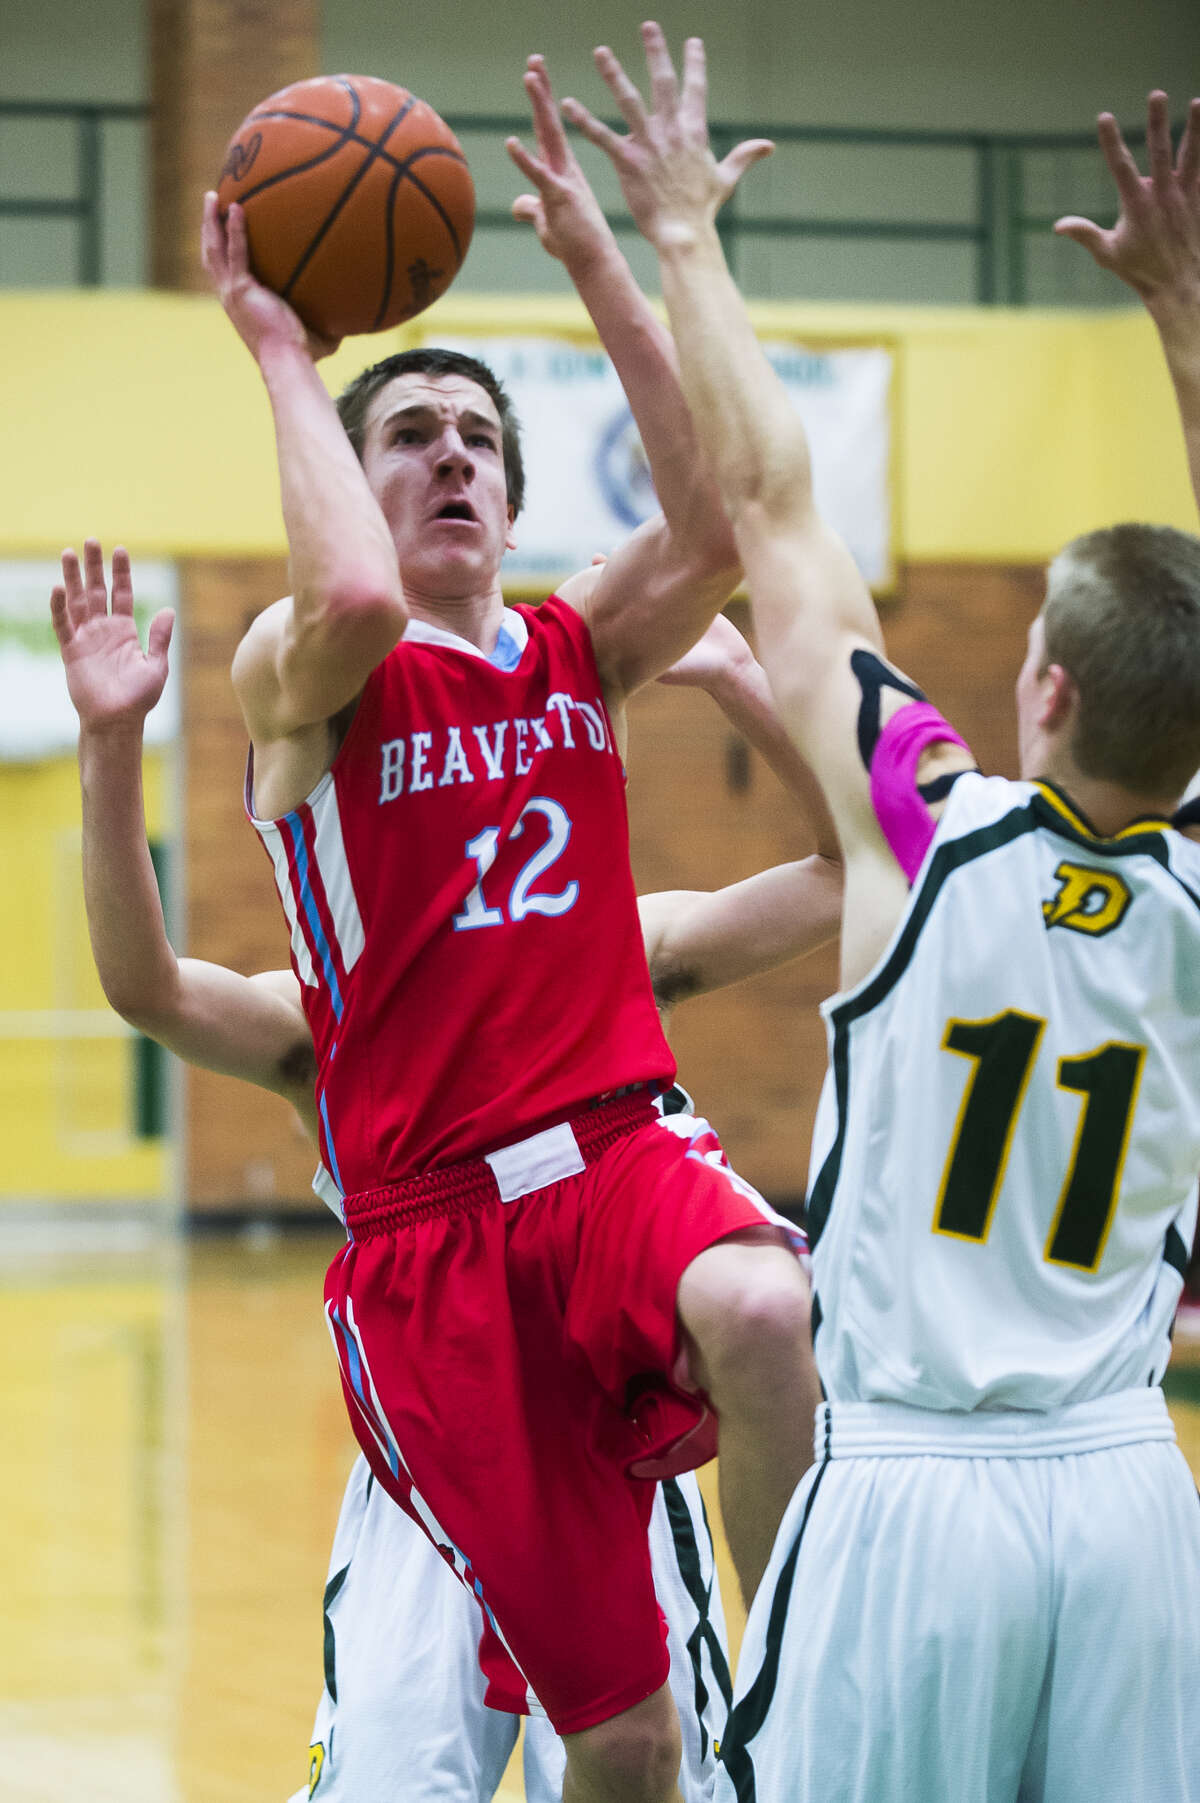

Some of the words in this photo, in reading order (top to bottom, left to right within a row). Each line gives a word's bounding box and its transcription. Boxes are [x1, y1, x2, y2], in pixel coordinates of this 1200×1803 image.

[378, 692, 613, 806] BEAVERTO
[453, 796, 580, 931] 12
[931, 1007, 1147, 1273] 11
